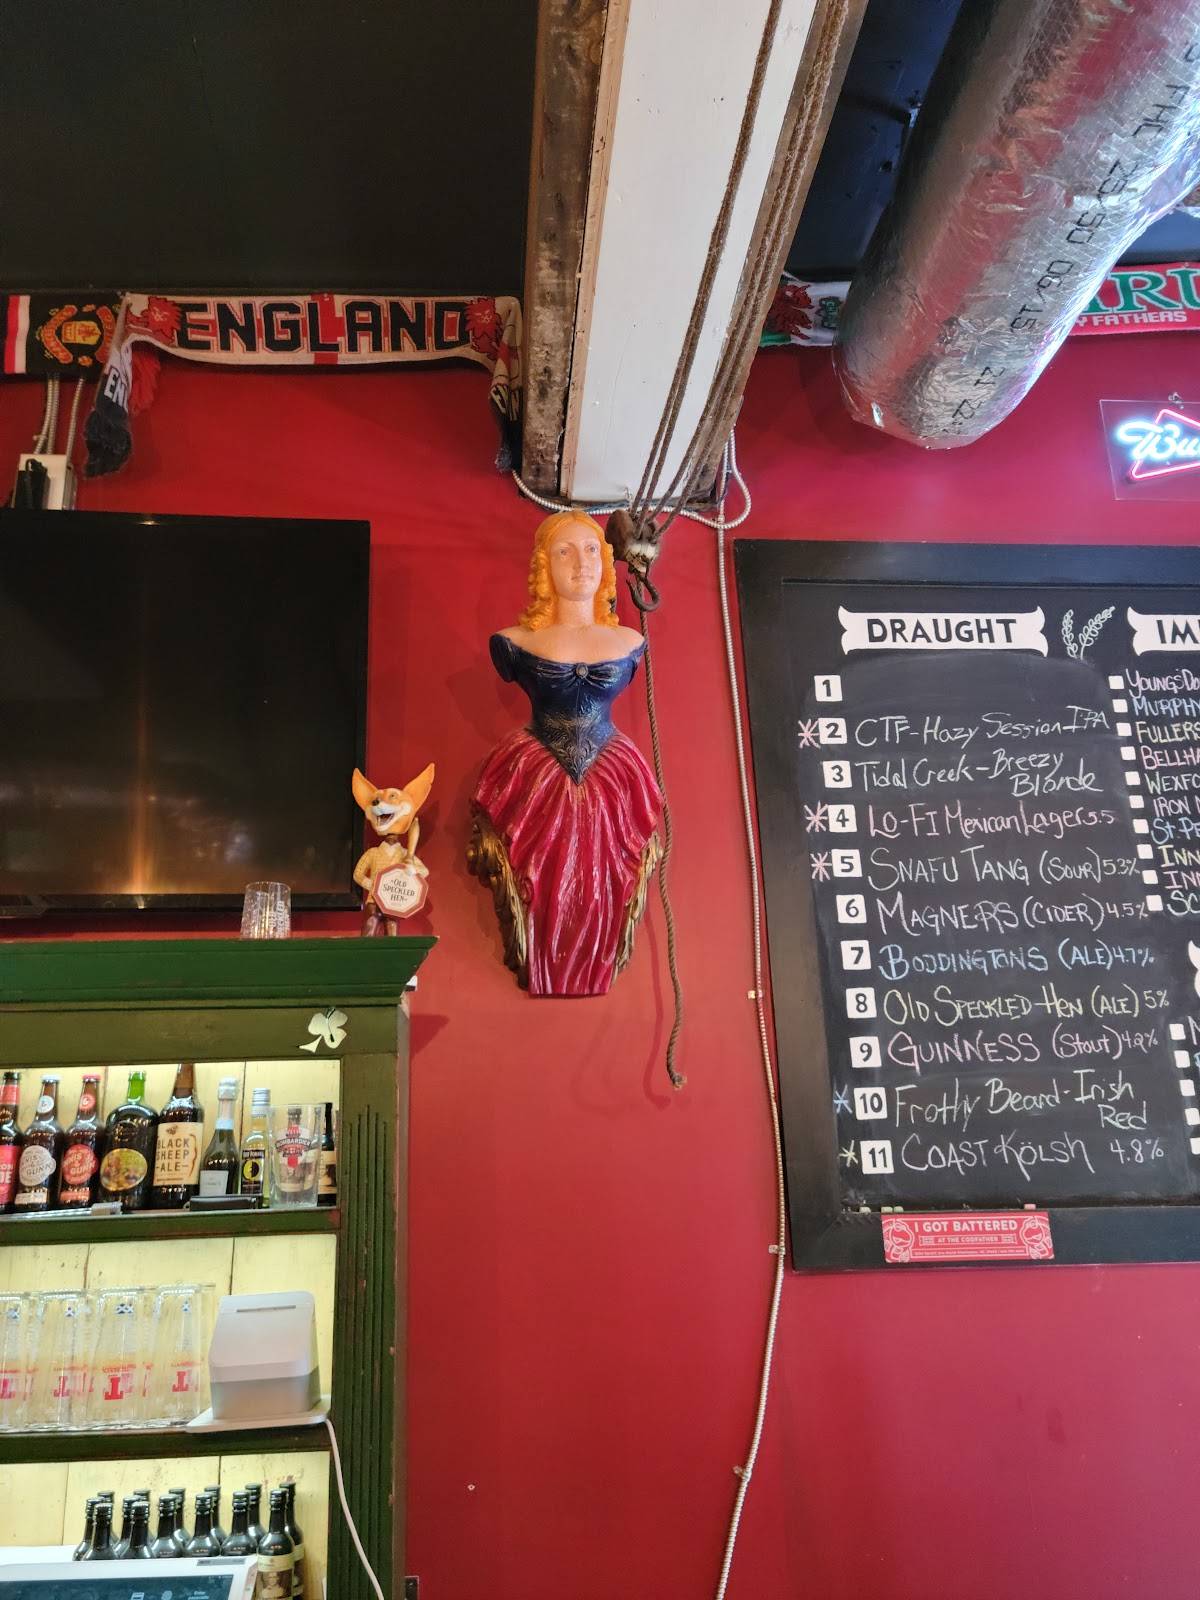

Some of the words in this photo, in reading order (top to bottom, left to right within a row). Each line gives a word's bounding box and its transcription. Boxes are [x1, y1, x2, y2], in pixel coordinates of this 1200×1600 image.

[178, 300, 473, 352] ENGLAND
[1092, 311, 1188, 326] FATHERS
[866, 618, 1016, 643] DRAUGHT
[1156, 619, 1200, 645] IM
[822, 679, 832, 697] 1
[825, 722, 842, 738] 2
[831, 764, 844, 782] 3
[855, 758, 907, 792] Tidal
[1009, 757, 1104, 797] Blonde
[836, 809, 849, 828] 4
[944, 800, 1022, 839] Mexican
[1153, 796, 1191, 817] IRON
[840, 856, 854, 873] 5
[868, 847, 959, 891] SNAFU
[960, 844, 1030, 886] TANG
[845, 898, 859, 918] 6
[876, 891, 1019, 936] MAGNERS
[851, 946, 864, 965] 7
[1058, 937, 1113, 970] (ALE)
[855, 993, 868, 1013] 8
[1091, 983, 1139, 1018] (ALE)
[1143, 989, 1170, 1009] 5%
[859, 1042, 873, 1062] 9
[888, 1029, 1041, 1076] GUINNESS
[859, 1092, 884, 1114] 10
[1098, 1101, 1147, 1130] Red
[157, 1137, 190, 1149] BLACK
[157, 1150, 189, 1161] SHEEP
[868, 1147, 888, 1168] 11
[901, 1133, 989, 1176] COAST
[1110, 1137, 1165, 1164] 4.8%
[923, 1221, 948, 1233] GOT
[953, 1219, 1018, 1232] BATTERED
